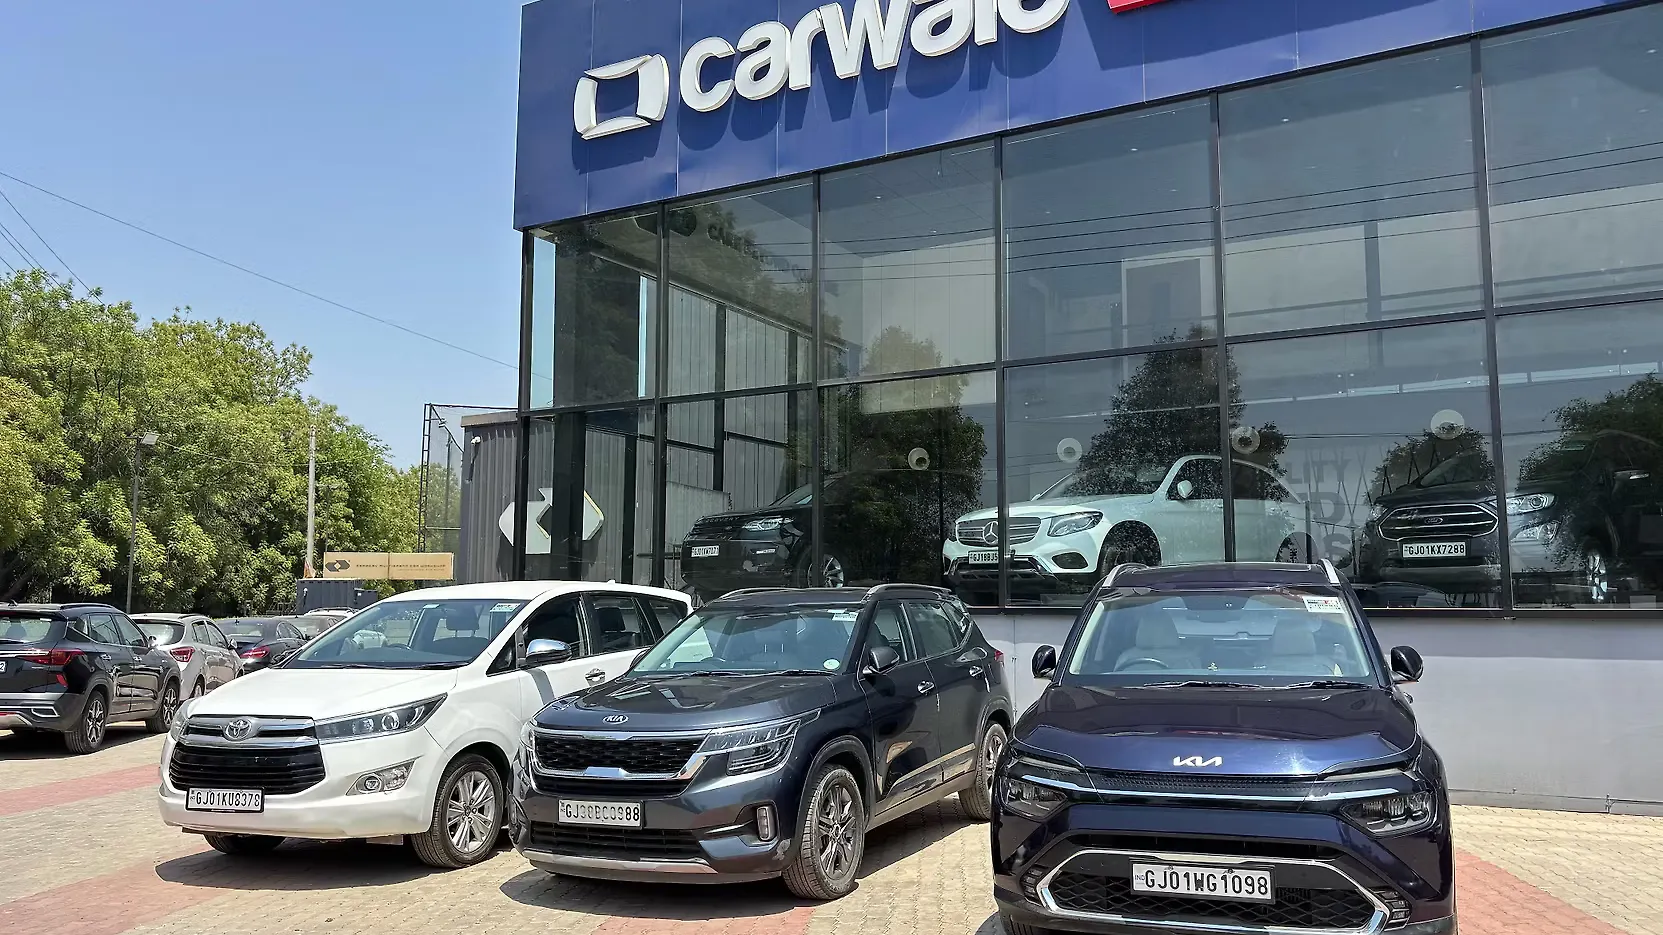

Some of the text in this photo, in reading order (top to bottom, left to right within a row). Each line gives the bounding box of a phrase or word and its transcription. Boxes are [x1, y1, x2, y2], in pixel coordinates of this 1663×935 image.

[1408, 544, 1465, 555] GJ01KX7288
[972, 552, 1000, 562] GJ18BJ5
[196, 791, 260, 807] GJ01KU8378
[1145, 869, 1268, 895] GJ01WG1098
